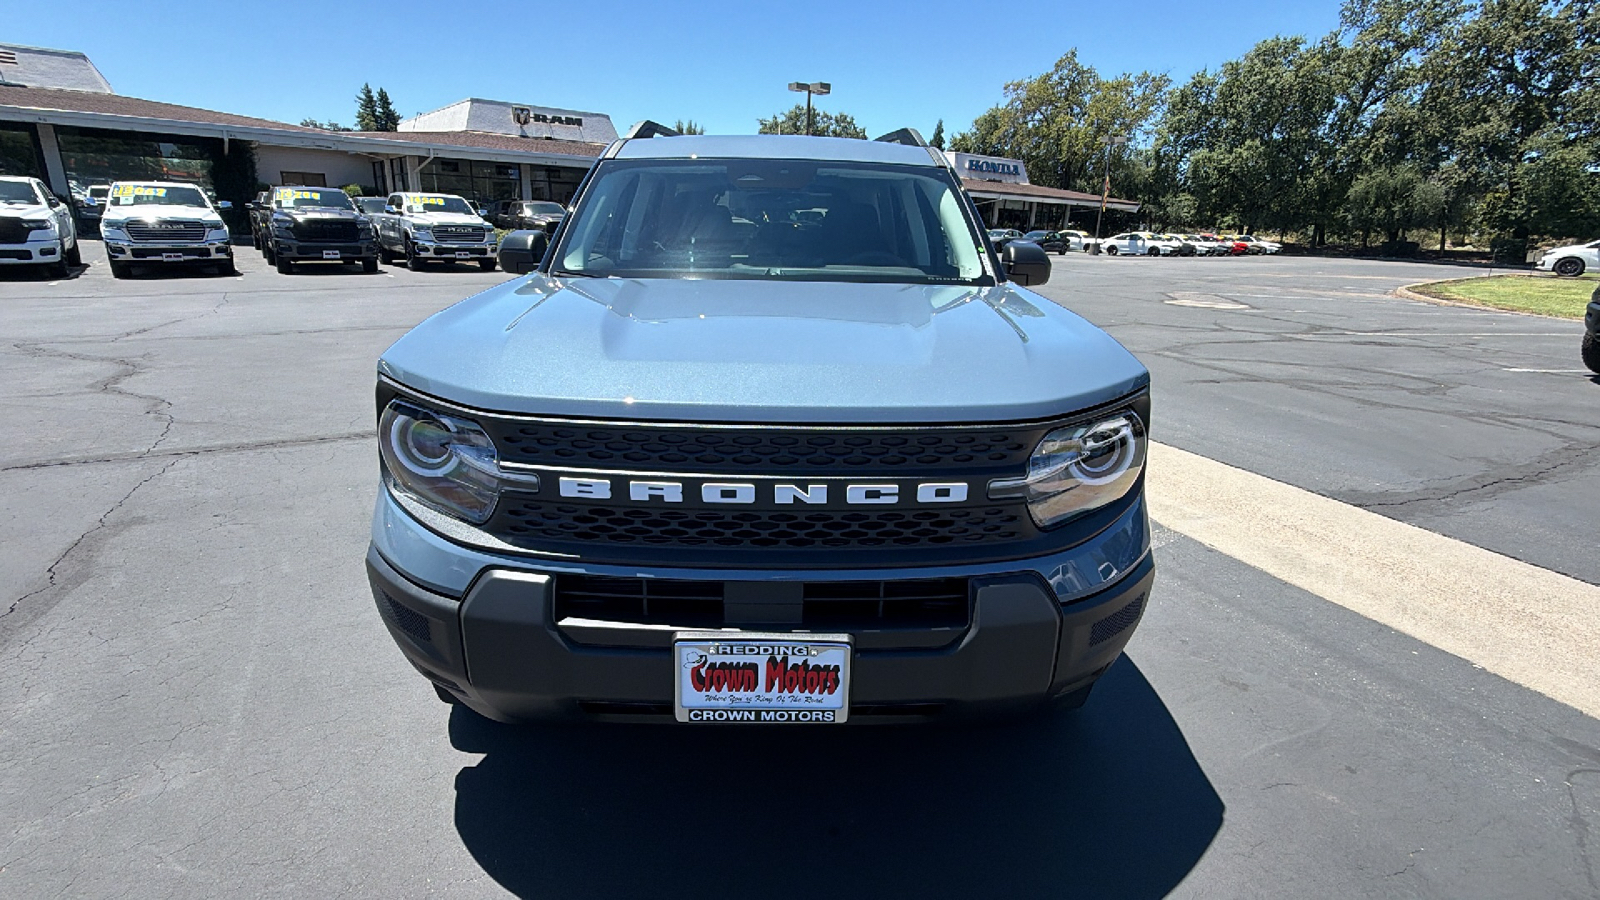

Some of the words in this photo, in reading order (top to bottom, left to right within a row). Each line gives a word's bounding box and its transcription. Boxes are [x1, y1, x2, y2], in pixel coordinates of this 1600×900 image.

[533, 113, 583, 127] RAM
[967, 158, 1020, 176] HONDA
[559, 476, 969, 505] BRONCO
[718, 646, 808, 656] REDDING
[690, 656, 759, 693] Crown
[764, 655, 841, 695] Motors
[690, 710, 756, 721] CROWN
[760, 710, 834, 722] MOTORS
